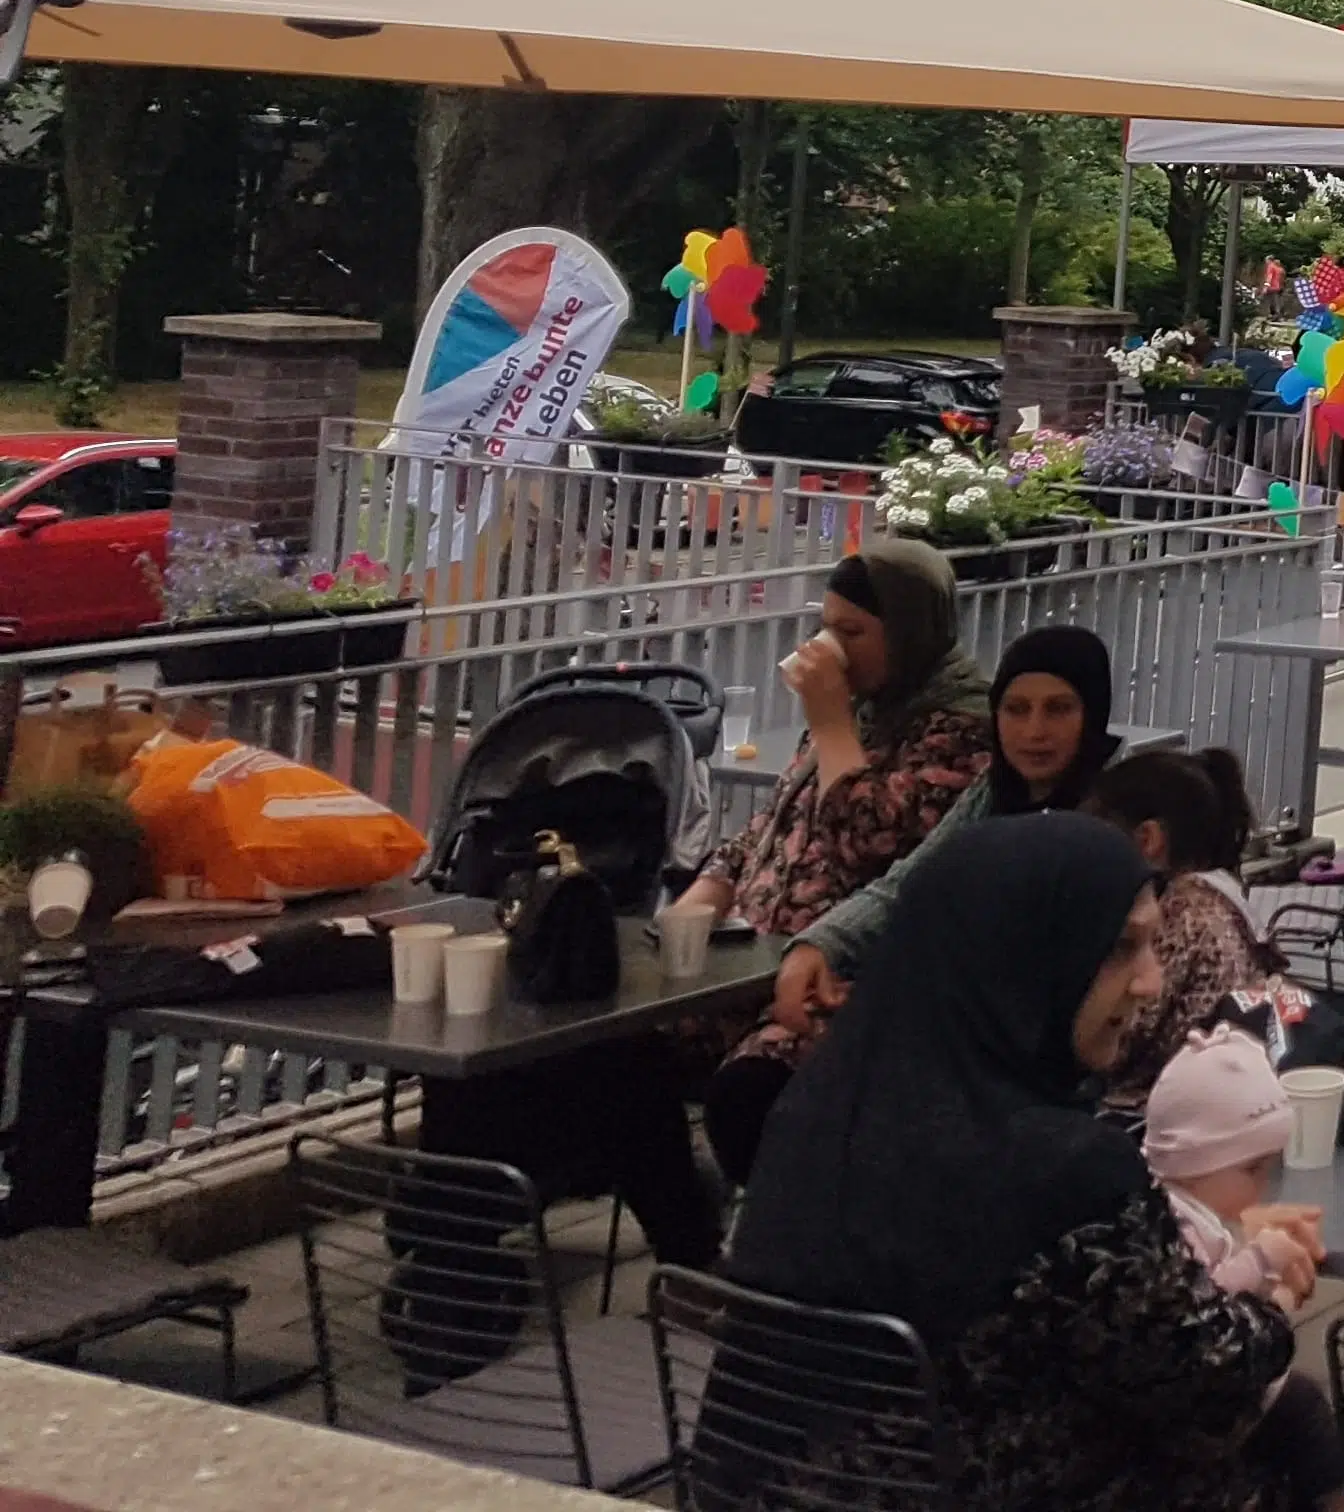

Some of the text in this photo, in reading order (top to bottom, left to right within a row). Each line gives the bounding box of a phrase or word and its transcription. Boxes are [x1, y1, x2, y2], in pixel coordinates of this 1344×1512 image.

[522, 295, 584, 382] bunte
[472, 355, 521, 418] bieten
[525, 349, 588, 438] Leben
